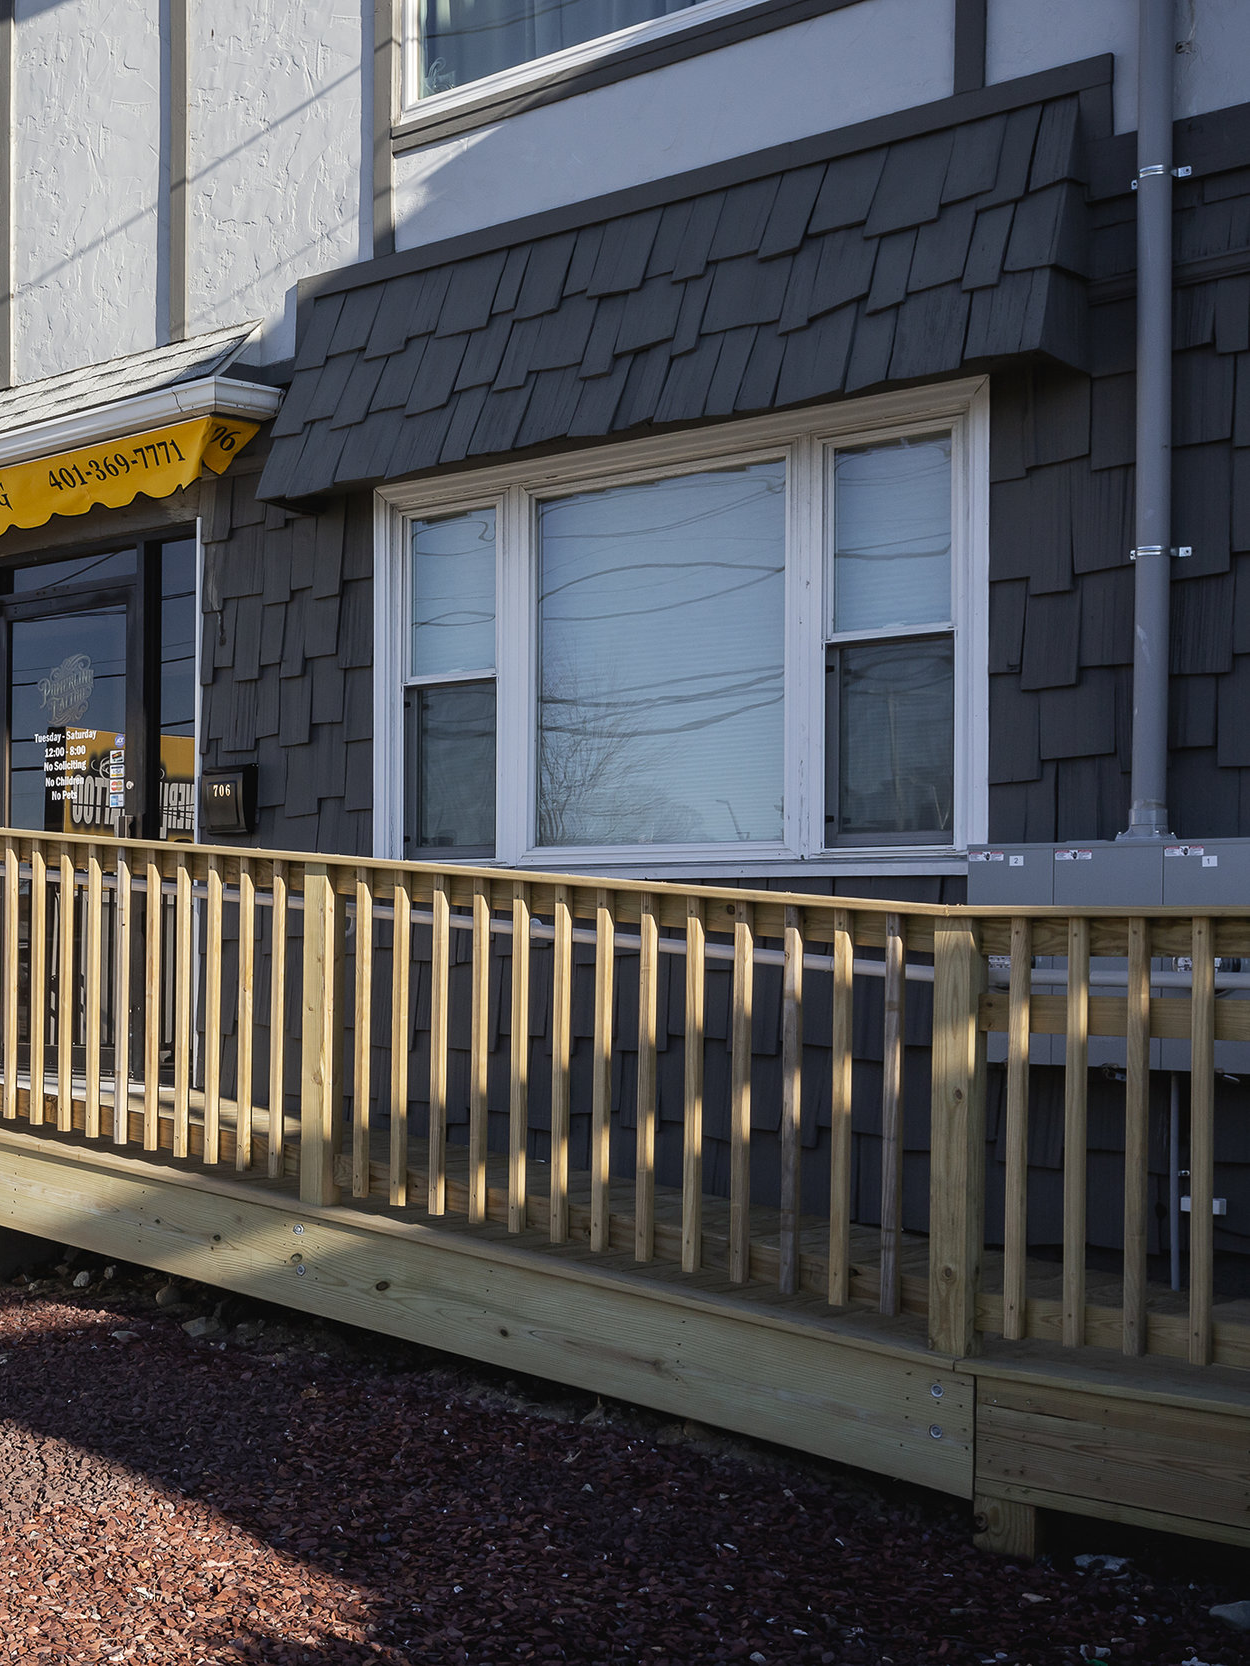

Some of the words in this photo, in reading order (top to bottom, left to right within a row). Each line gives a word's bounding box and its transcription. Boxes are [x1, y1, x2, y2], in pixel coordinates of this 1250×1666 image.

[48, 438, 186, 491] 401-369-7771
[34, 732, 61, 743] Tuesday
[66, 729, 97, 740] Saturday
[44, 747, 65, 758] 12:00
[70, 745, 86, 756] 8:00
[44, 762, 53, 771] No
[54, 760, 87, 771] Soliciting
[46, 777, 54, 787] No
[56, 776, 84, 786] Children
[51, 791, 61, 800] No
[62, 790, 78, 800] Pets
[213, 784, 231, 797] 706
